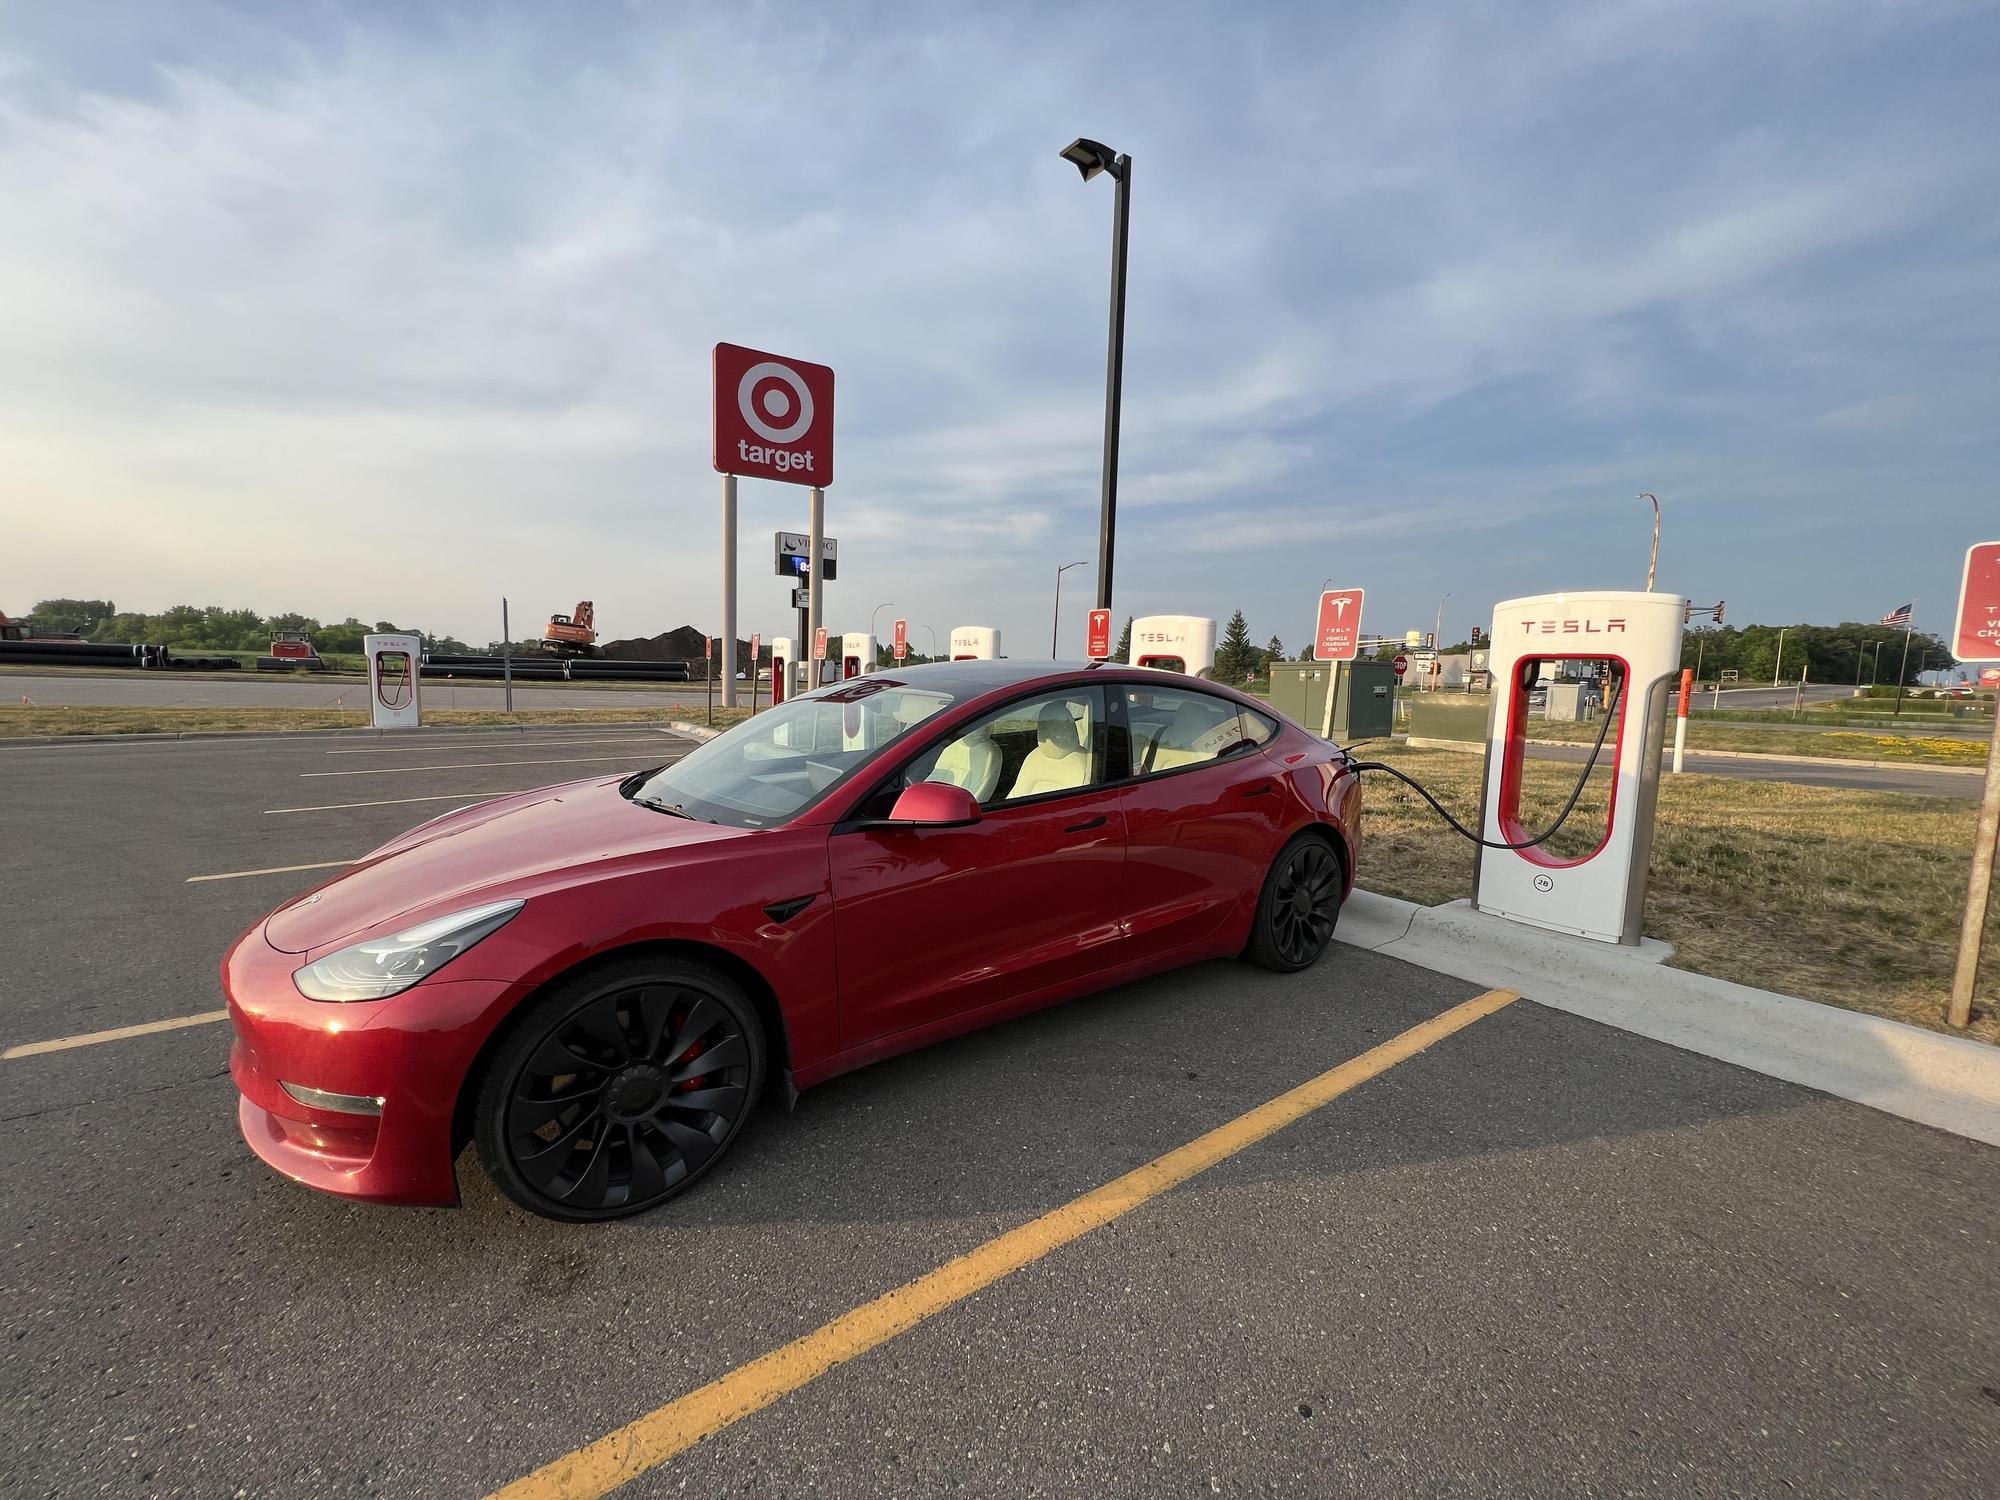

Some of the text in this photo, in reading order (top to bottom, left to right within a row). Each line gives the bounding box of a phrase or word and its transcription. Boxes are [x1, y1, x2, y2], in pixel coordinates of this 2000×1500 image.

[738, 439, 814, 472] target
[1521, 619, 1626, 634] TESLA
[1140, 633, 1184, 642] TESLA
